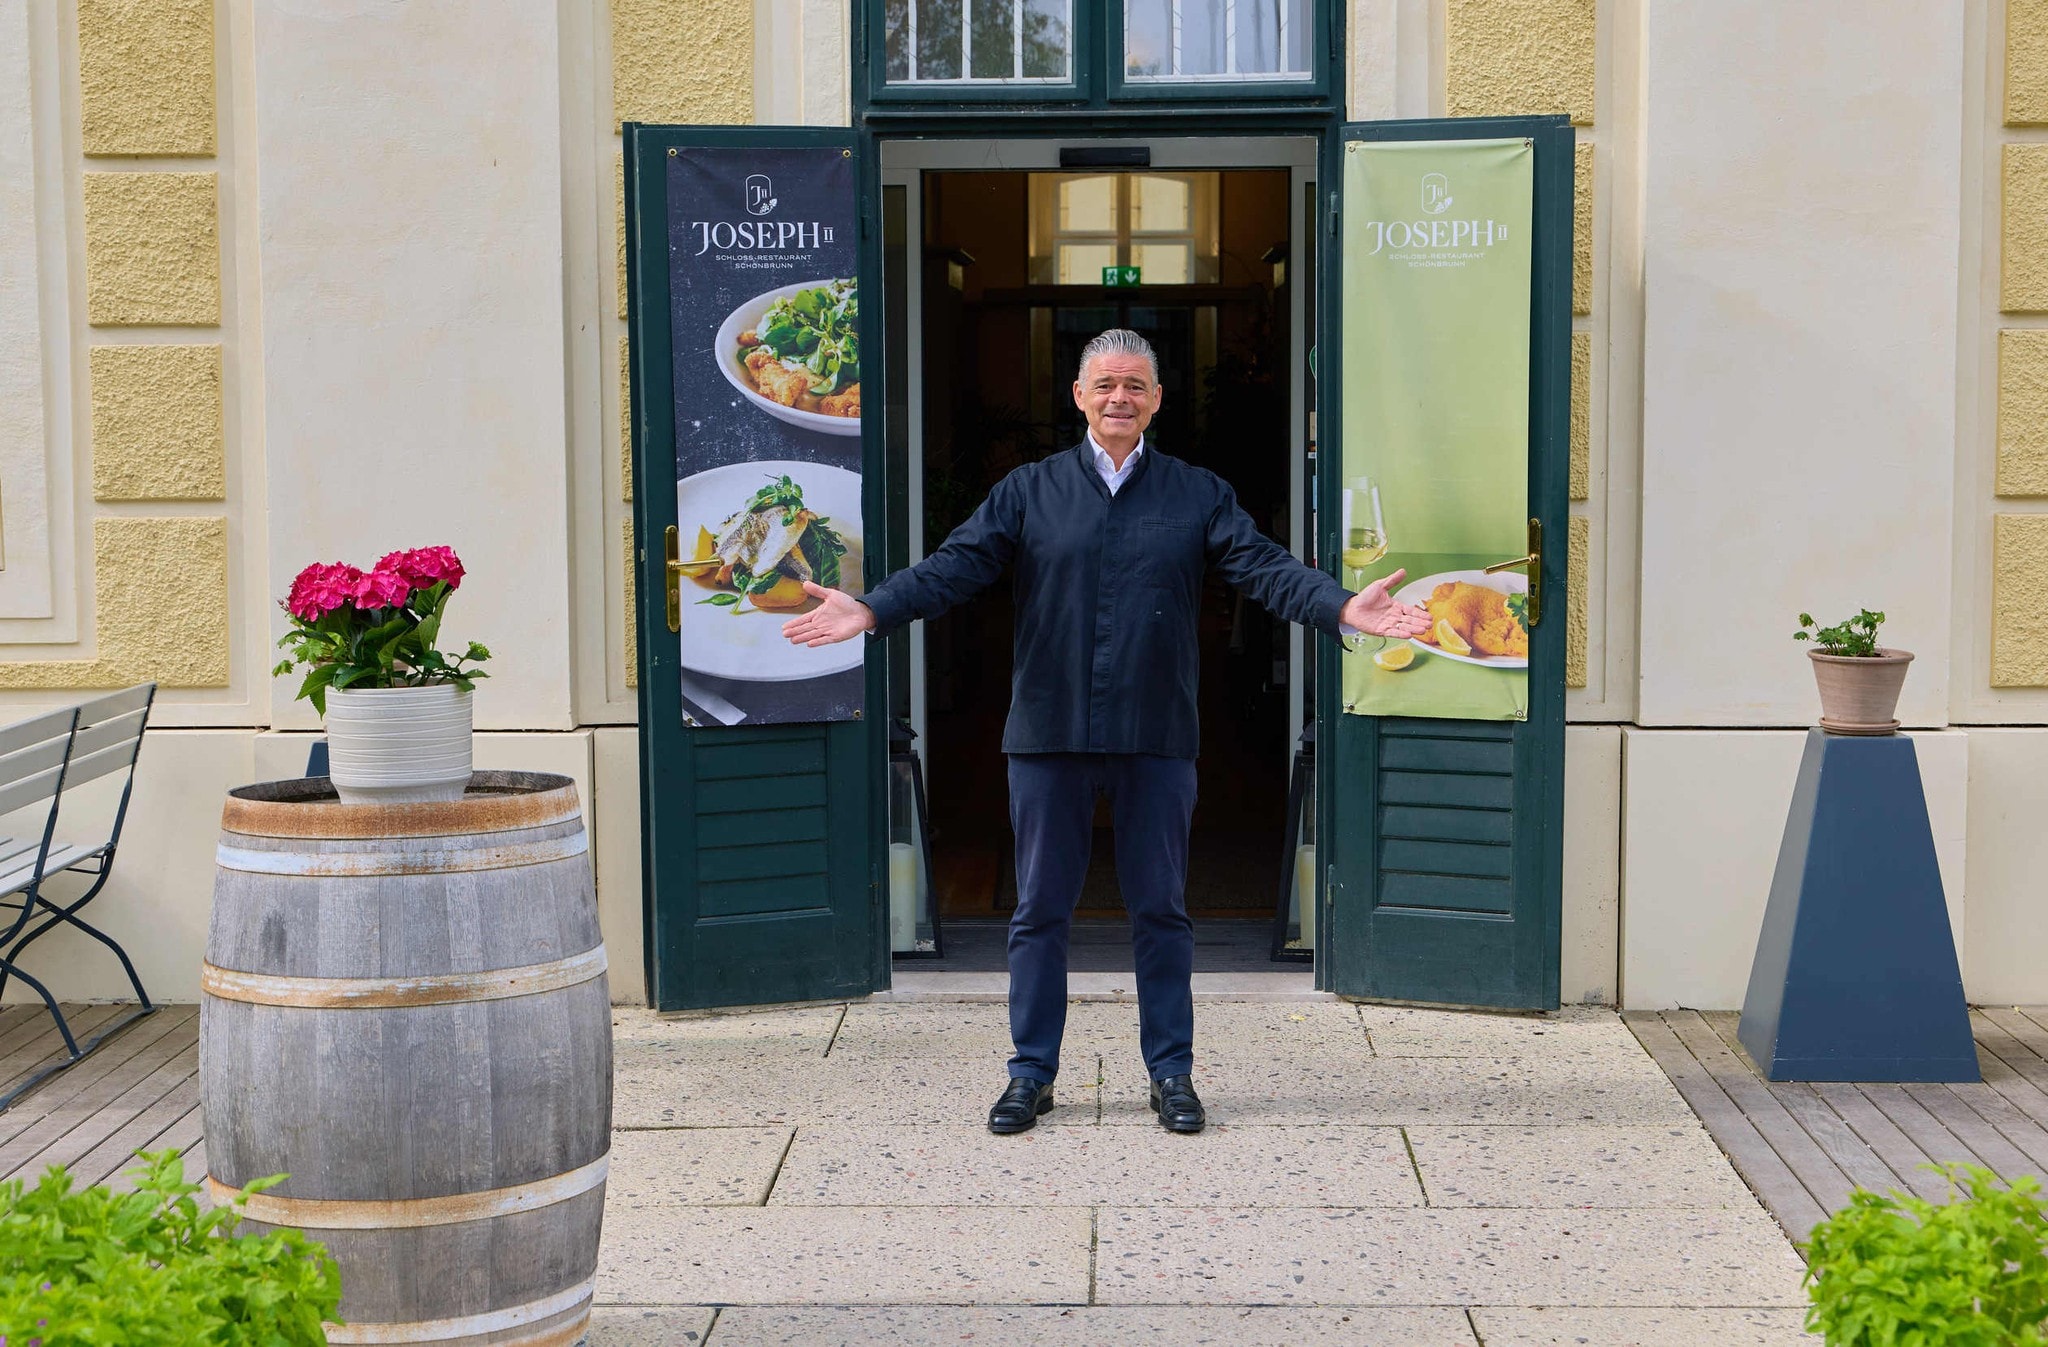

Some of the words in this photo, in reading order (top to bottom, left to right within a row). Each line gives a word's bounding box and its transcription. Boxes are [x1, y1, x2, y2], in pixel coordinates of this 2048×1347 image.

[692, 221, 820, 256] JOSEPH
[1366, 220, 1494, 256] JOSEPH
[735, 261, 794, 269] SCHÖNBRUNN
[1408, 260, 1466, 268] SCHÖNBRUNN
